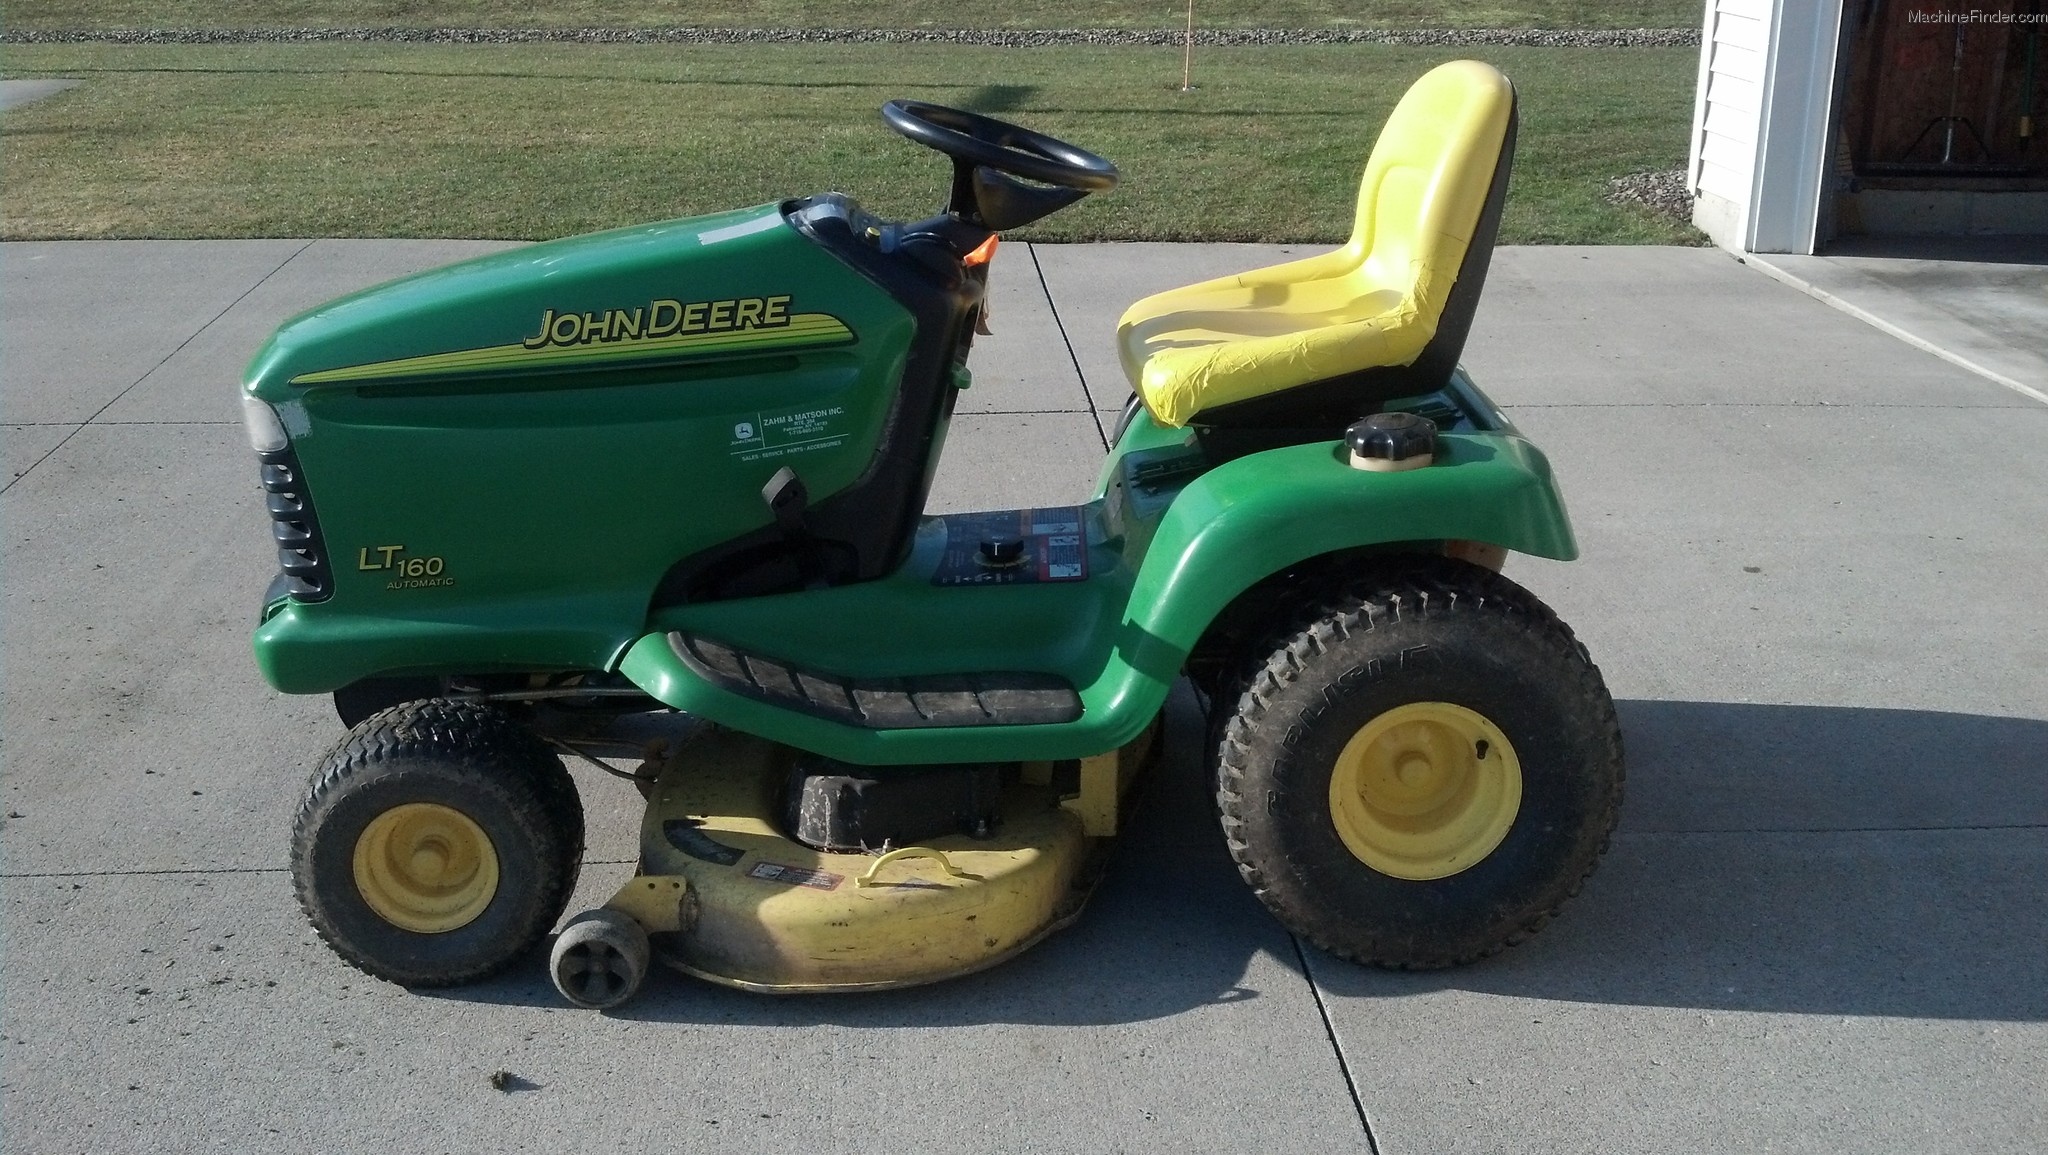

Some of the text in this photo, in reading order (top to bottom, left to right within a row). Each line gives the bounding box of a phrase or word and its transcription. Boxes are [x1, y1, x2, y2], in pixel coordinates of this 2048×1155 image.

[524, 295, 792, 350] JOHN DEERE
[763, 416, 786, 426] ZAHM
[794, 409, 828, 421] MATSON
[829, 407, 845, 416] INC.
[359, 545, 444, 578] LT 160
[386, 577, 454, 590] AUTOMATIC
